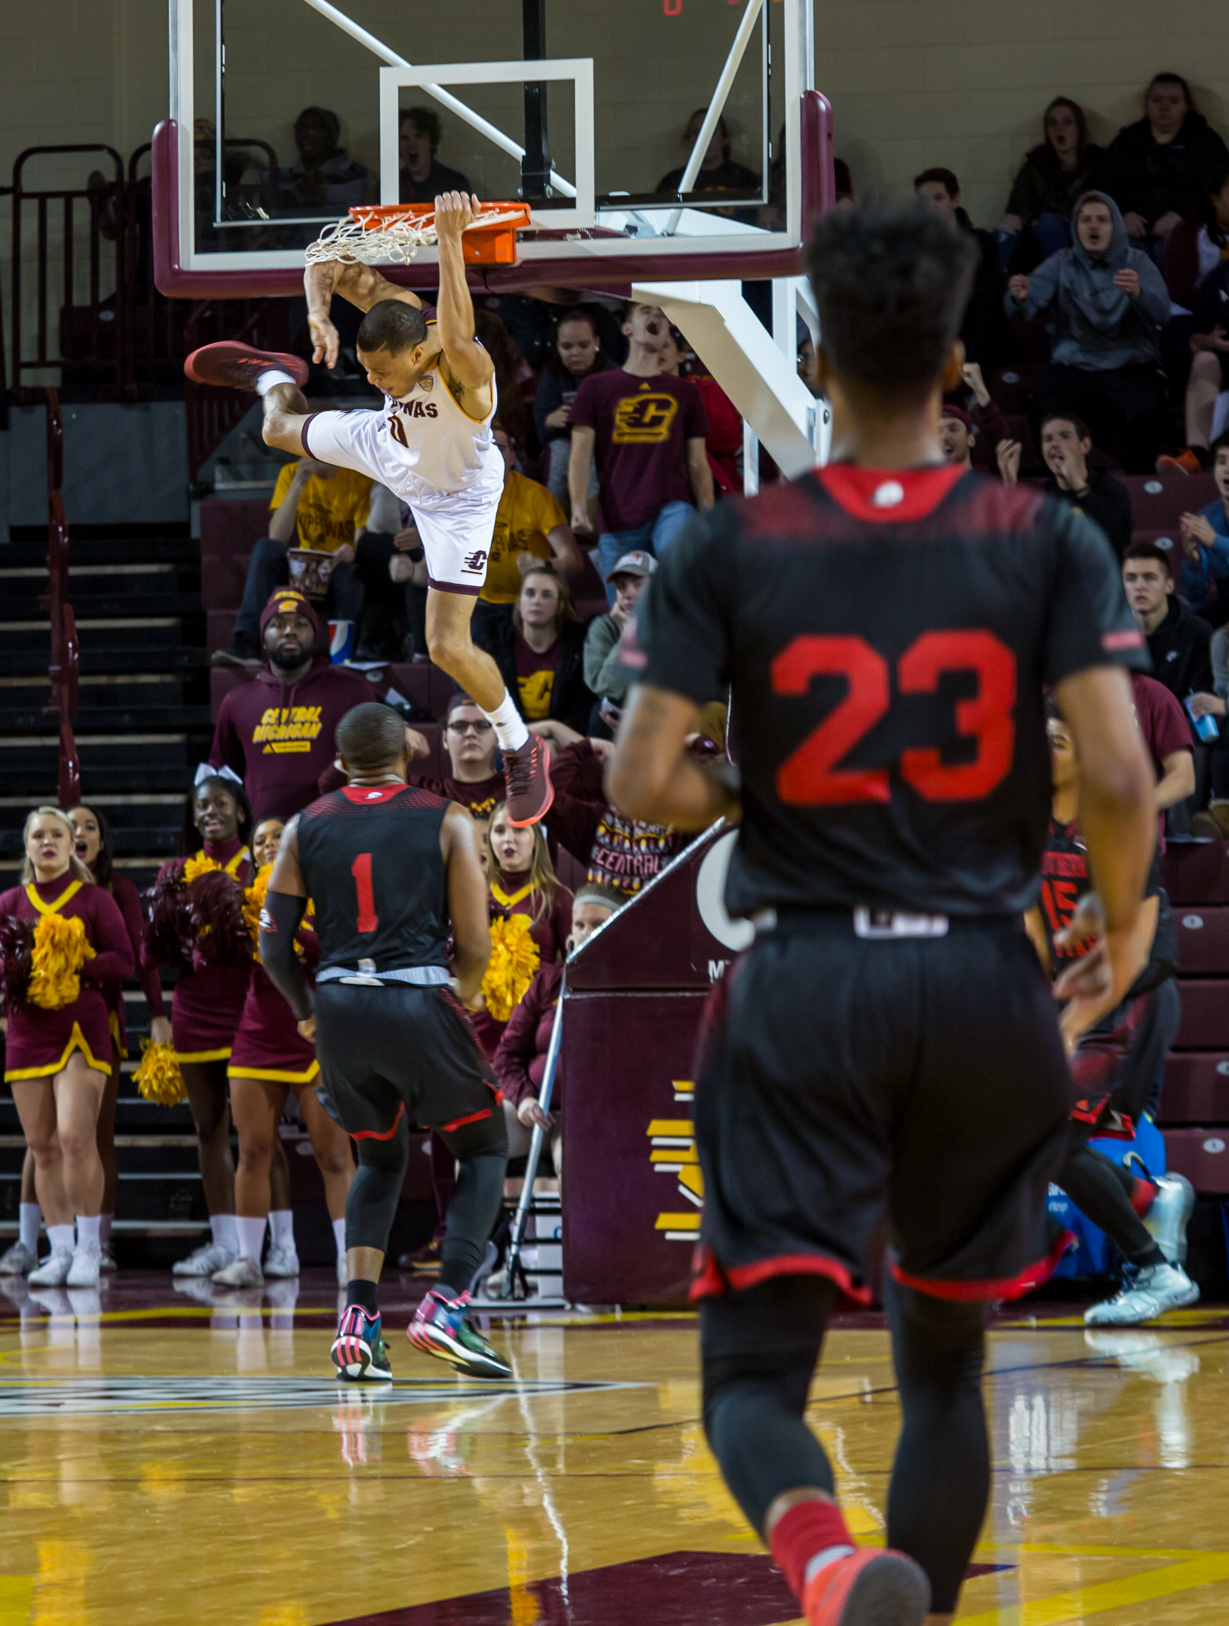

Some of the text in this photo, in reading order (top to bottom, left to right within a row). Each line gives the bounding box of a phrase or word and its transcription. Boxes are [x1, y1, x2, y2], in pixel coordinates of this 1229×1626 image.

[261, 706, 322, 725] CENTRAL
[769, 629, 1018, 806] 23
[252, 722, 322, 743] MICHIGAN
[596, 848, 661, 875] CENTRAL
[351, 852, 378, 933] 1
